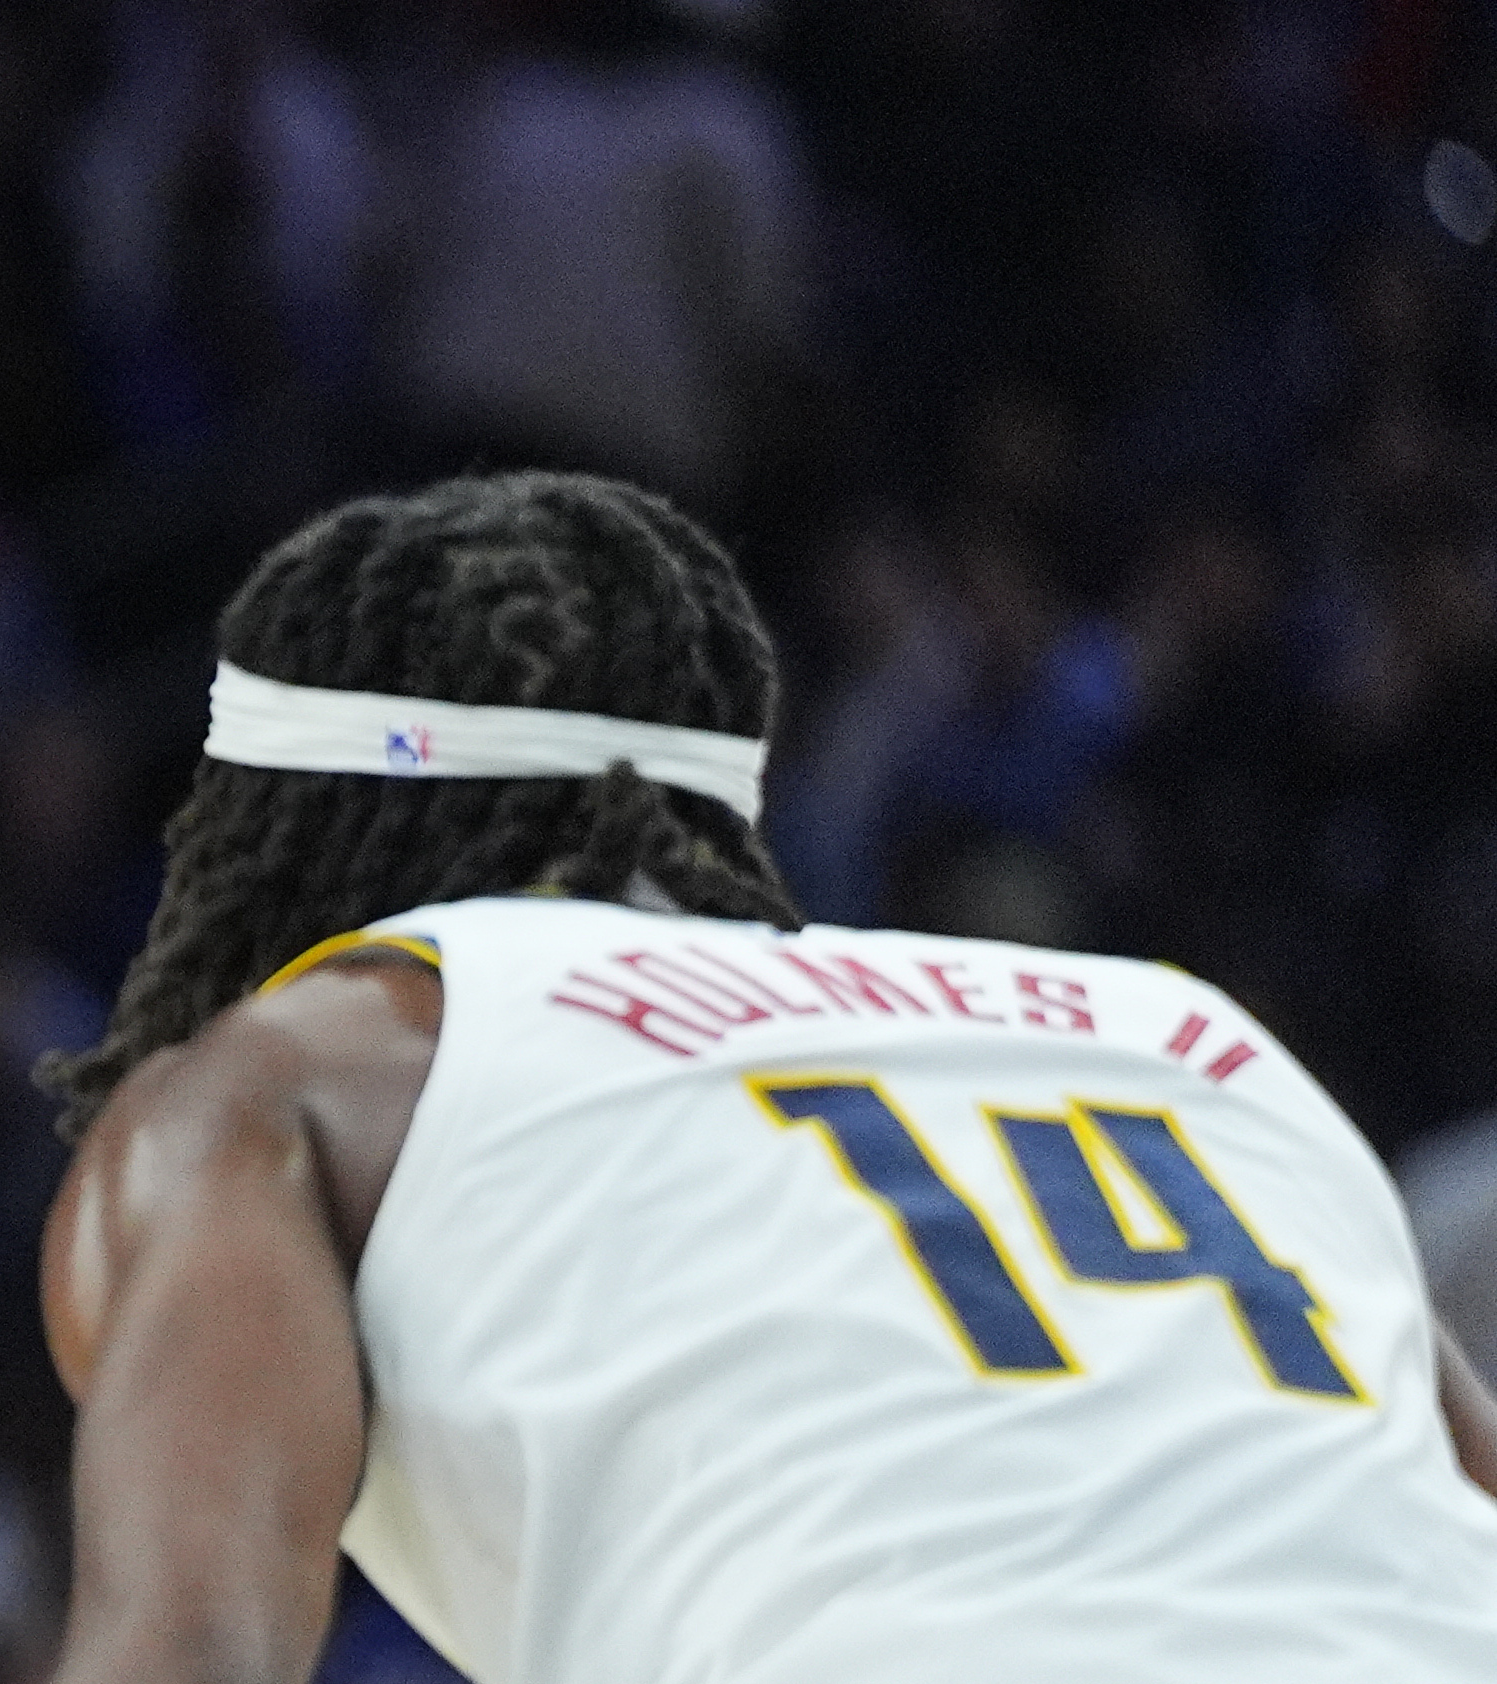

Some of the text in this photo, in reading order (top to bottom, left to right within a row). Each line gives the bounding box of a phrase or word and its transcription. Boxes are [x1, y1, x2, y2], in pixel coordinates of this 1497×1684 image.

[548, 944, 1259, 1083] HOLMES II
[743, 1069, 1377, 1407] 14
